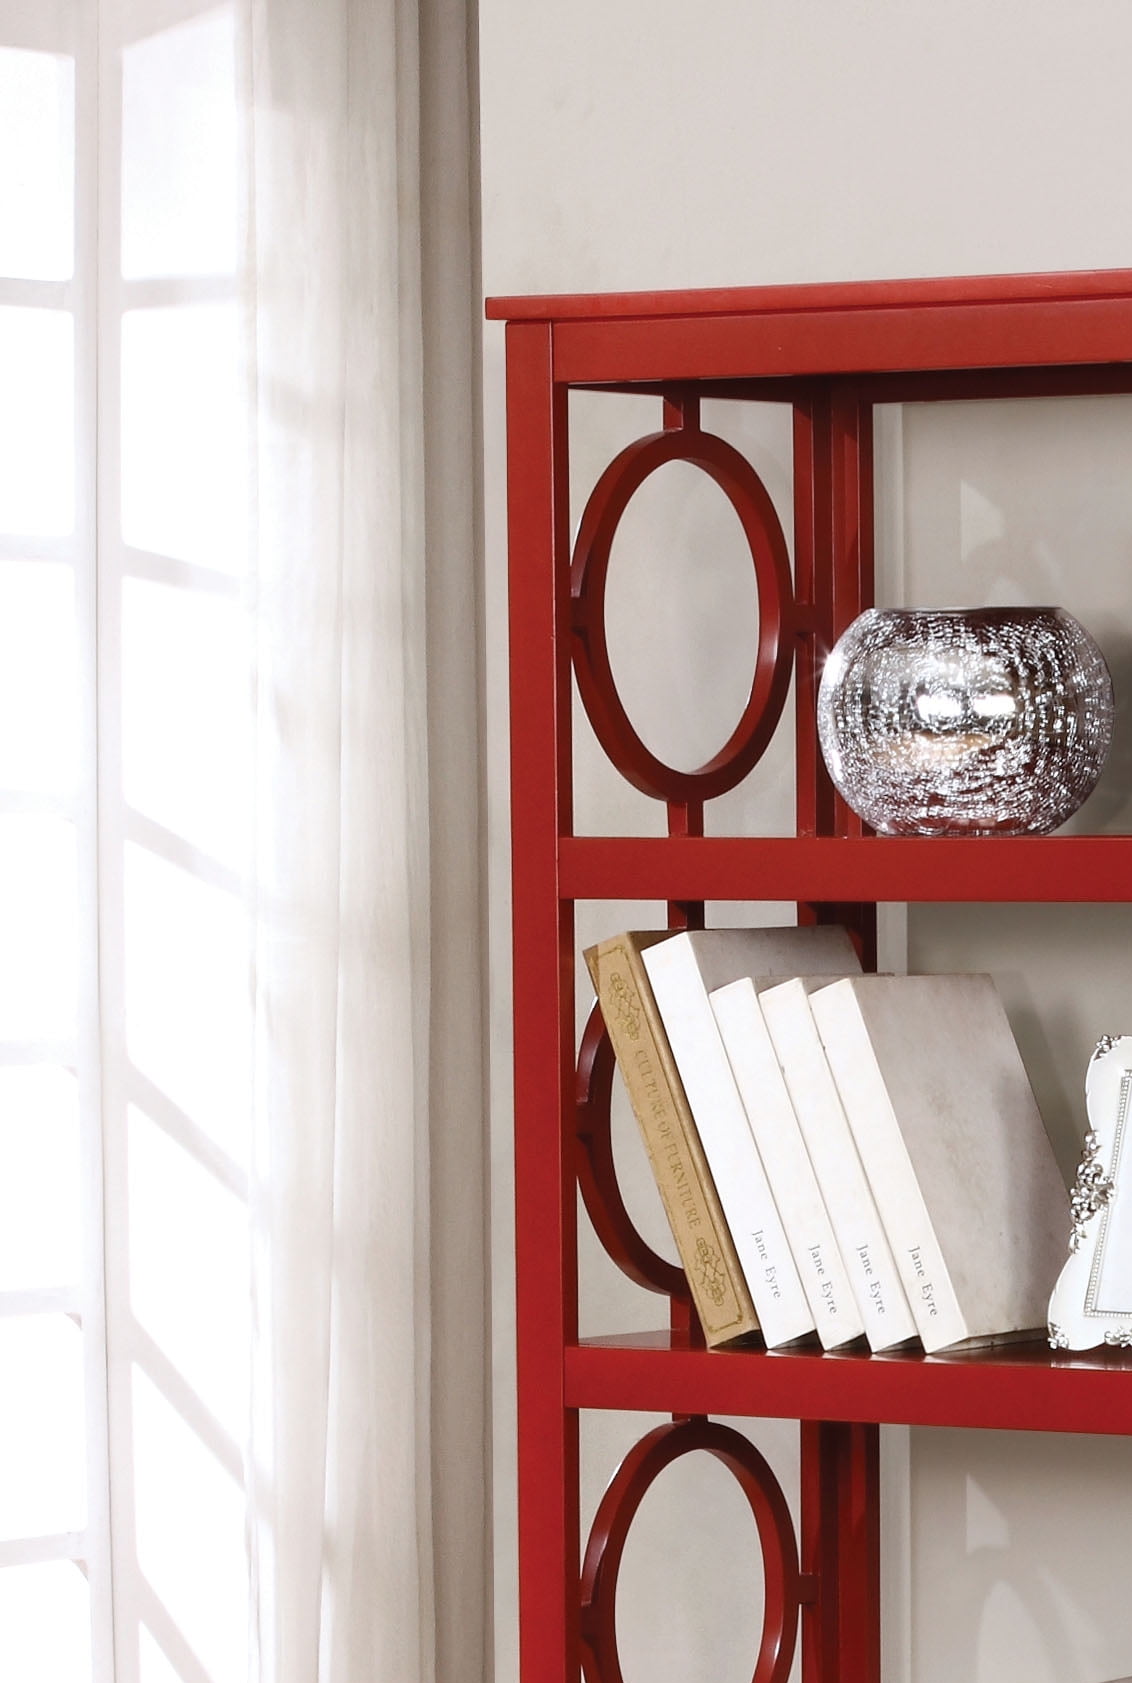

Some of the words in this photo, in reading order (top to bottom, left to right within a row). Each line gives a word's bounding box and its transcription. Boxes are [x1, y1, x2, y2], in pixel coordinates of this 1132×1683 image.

[635, 1049, 668, 1121] CULTURE
[657, 1121, 673, 1140] OF
[664, 1142, 702, 1230] FURNITURE
[752, 1229, 768, 1261] Jane
[765, 1265, 782, 1299] Eyre
[808, 1244, 825, 1276] Jane
[821, 1281, 838, 1315] Eyre
[856, 1243, 873, 1276] Jane
[869, 1281, 886, 1314] Eyre
[908, 1245, 925, 1278] Jane
[922, 1283, 939, 1317] Eyre
